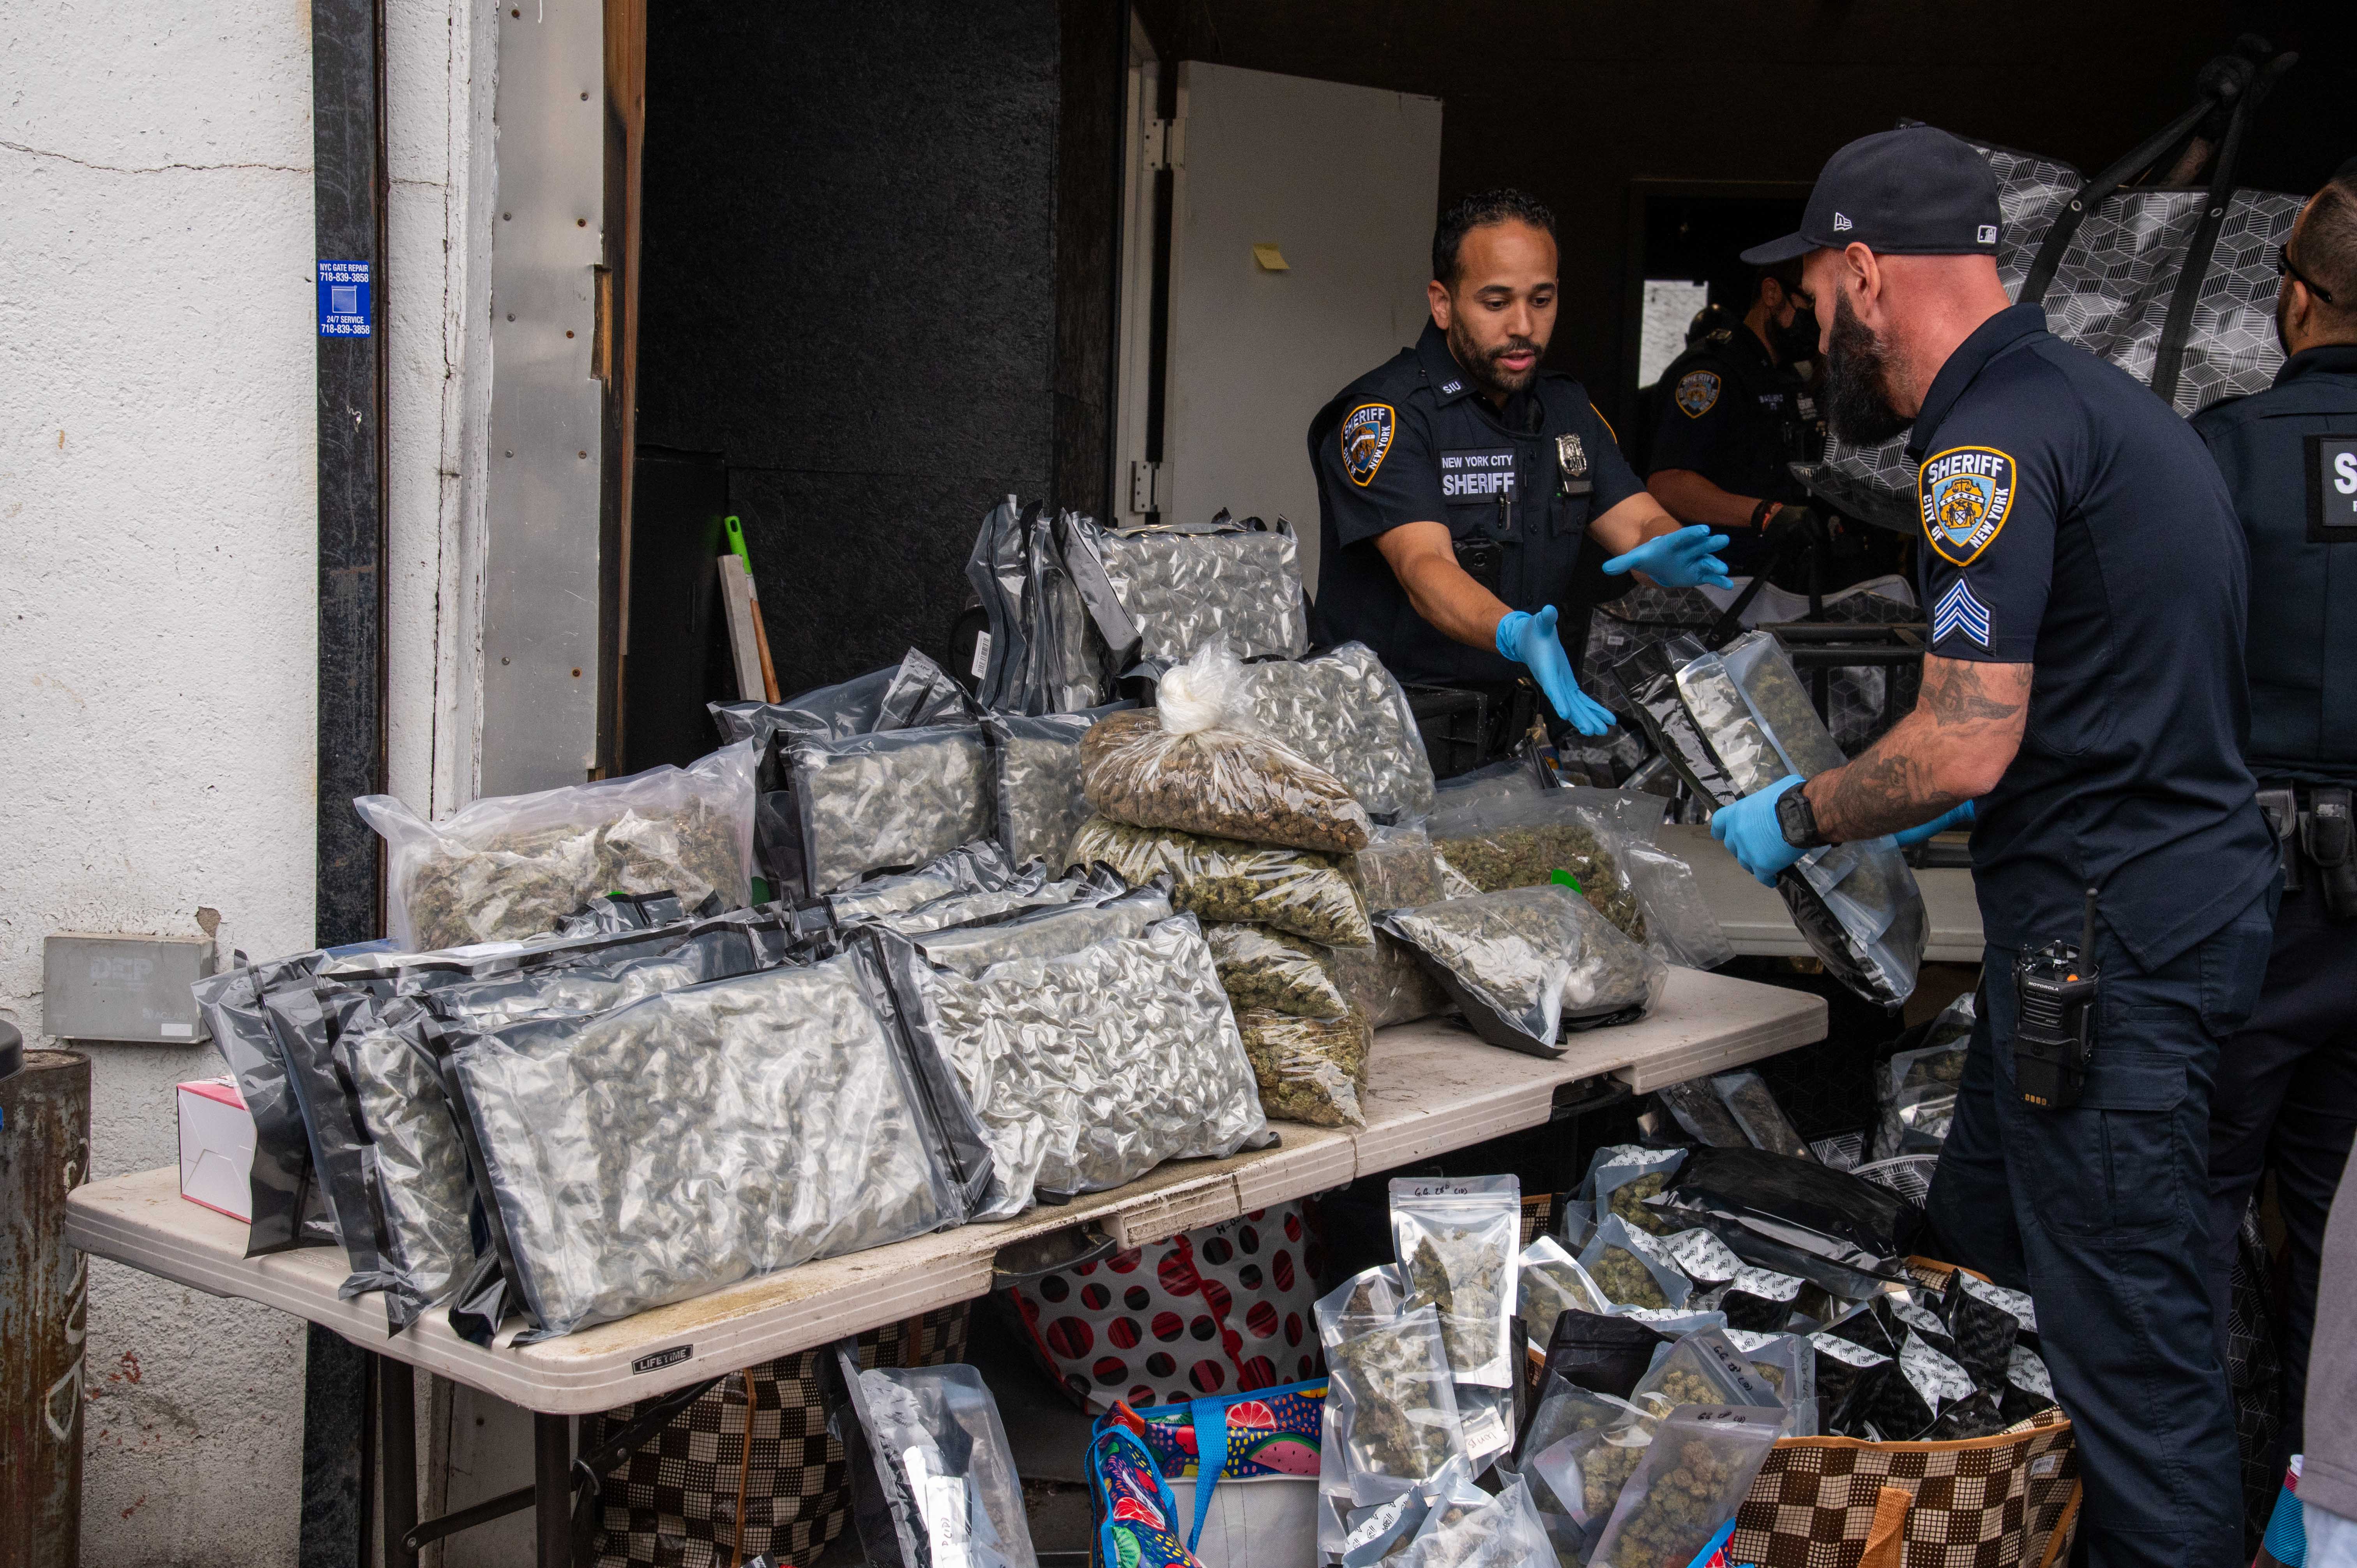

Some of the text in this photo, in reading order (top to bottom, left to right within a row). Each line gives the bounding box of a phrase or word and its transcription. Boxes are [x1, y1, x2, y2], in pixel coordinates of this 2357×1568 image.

[320, 273, 369, 282] 718-839-3858
[322, 324, 369, 334] 718-839-3858
[1443, 381, 1461, 394] SIU
[1344, 408, 1385, 440] SHERIFF
[1369, 425, 1391, 470] NEW YORK
[1442, 455, 1512, 468] NEW YORK CITY
[1928, 455, 2004, 484] SHERIFF
[1443, 472, 1514, 495] SHERIFF
[1923, 494, 1945, 542] CITY OF
[1969, 487, 2009, 549] NEW YORK
[2028, 982, 2059, 991] MOTOROLA
[640, 1349, 686, 1370] LIFETIME
